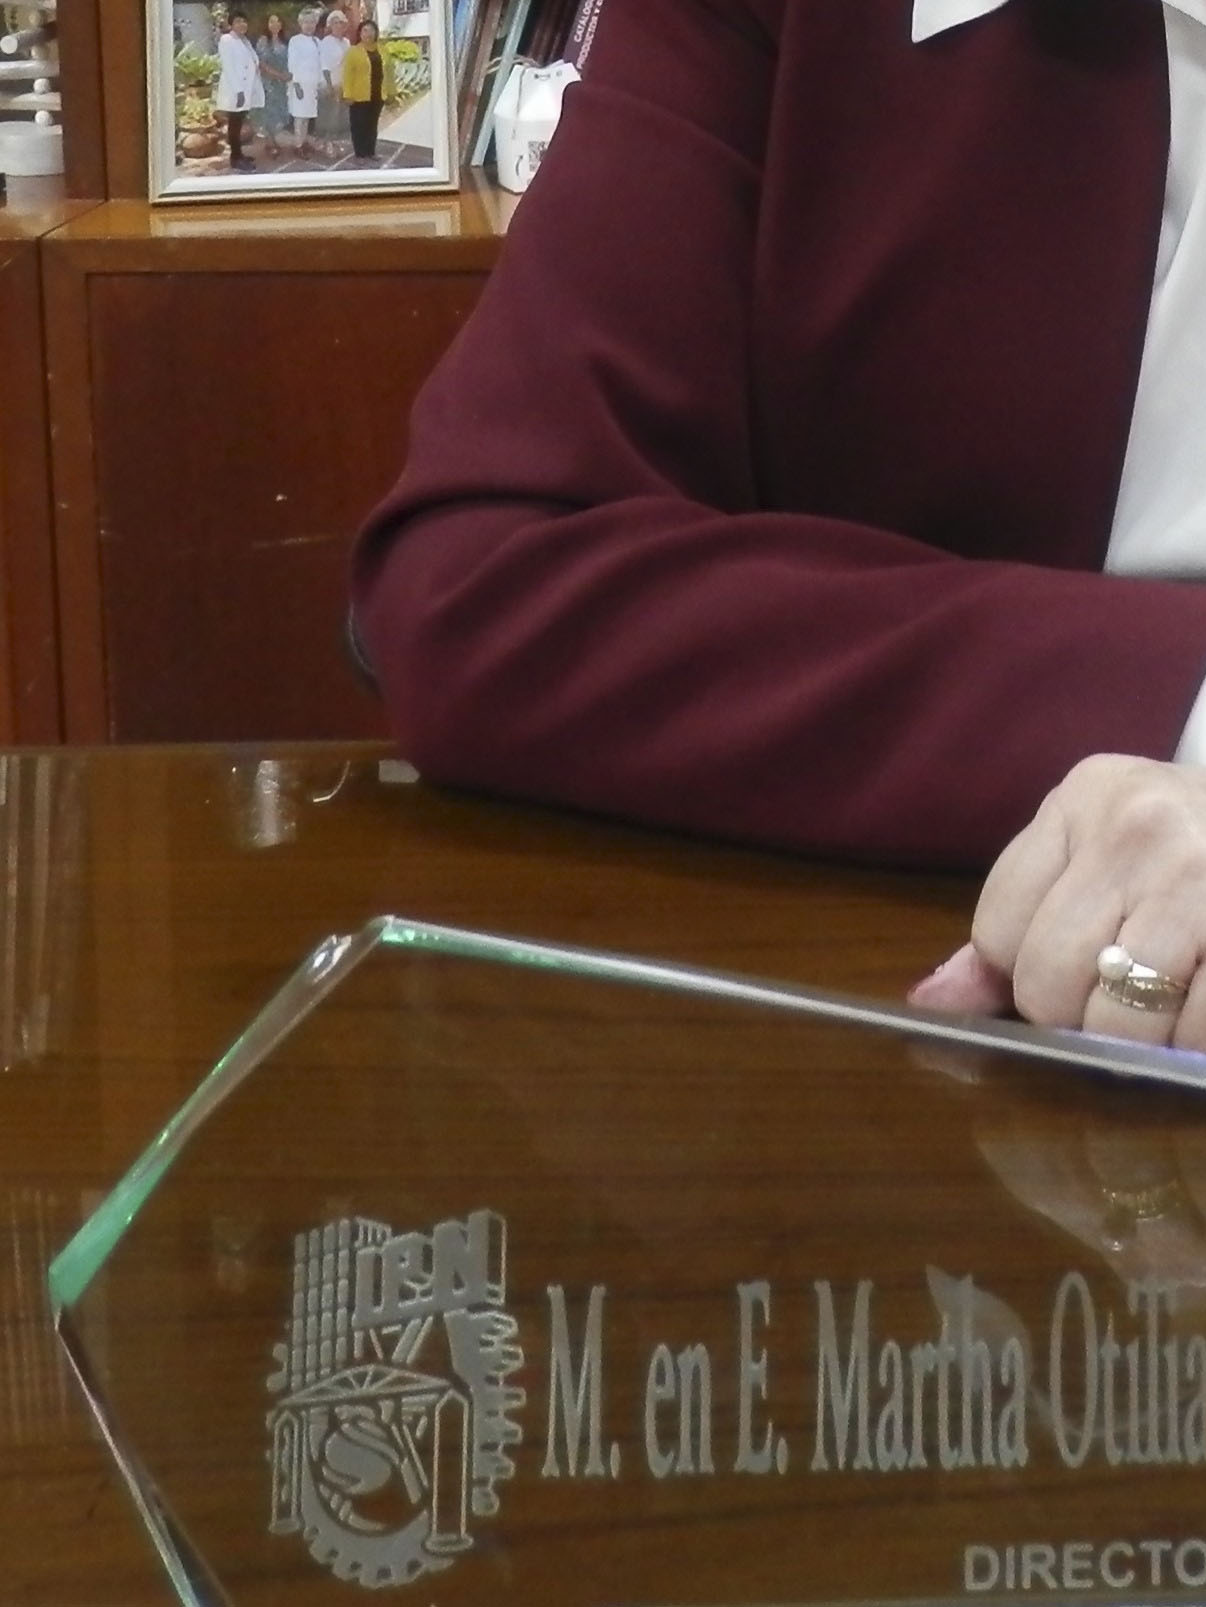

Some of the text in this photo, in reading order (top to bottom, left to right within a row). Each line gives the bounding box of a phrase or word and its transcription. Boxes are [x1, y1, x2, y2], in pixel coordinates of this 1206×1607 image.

[541, 1284, 620, 1477] M.
[645, 1342, 716, 1477] en
[733, 1280, 788, 1475] E.
[810, 1274, 1029, 1471] Martha
